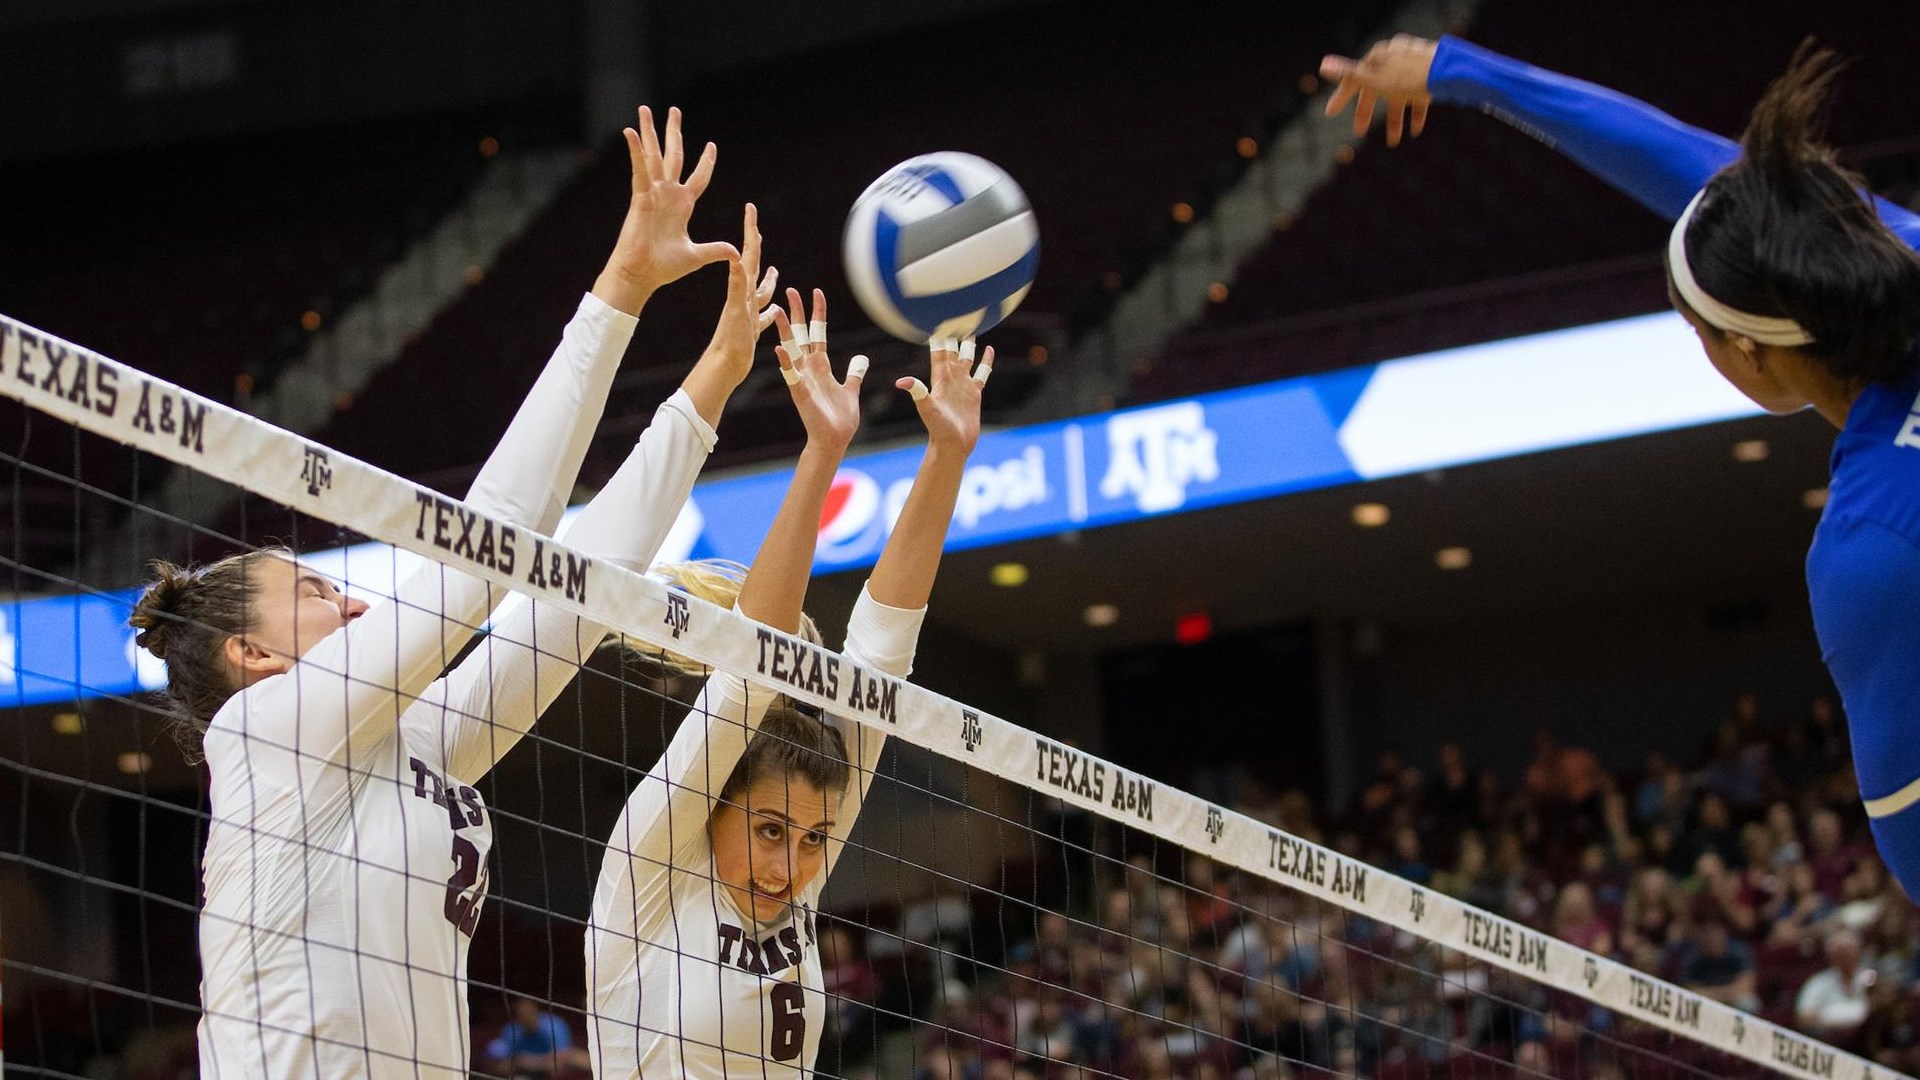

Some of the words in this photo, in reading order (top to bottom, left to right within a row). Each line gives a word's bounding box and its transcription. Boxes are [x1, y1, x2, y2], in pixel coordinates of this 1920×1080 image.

[133, 380, 206, 454] A&M
[885, 444, 1046, 536] ppsi
[415, 489, 516, 576] TEXAS
[528, 539, 588, 604] A&M
[757, 627, 839, 701] TEXAS
[848, 666, 897, 724] A&M
[1036, 739, 1105, 803] TEXAS
[1111, 771, 1153, 821] A&M
[1268, 831, 1327, 886] TEXAS
[1331, 858, 1368, 903] A&M
[1463, 910, 1512, 958] TEXAS
[770, 981, 806, 1061] 6
